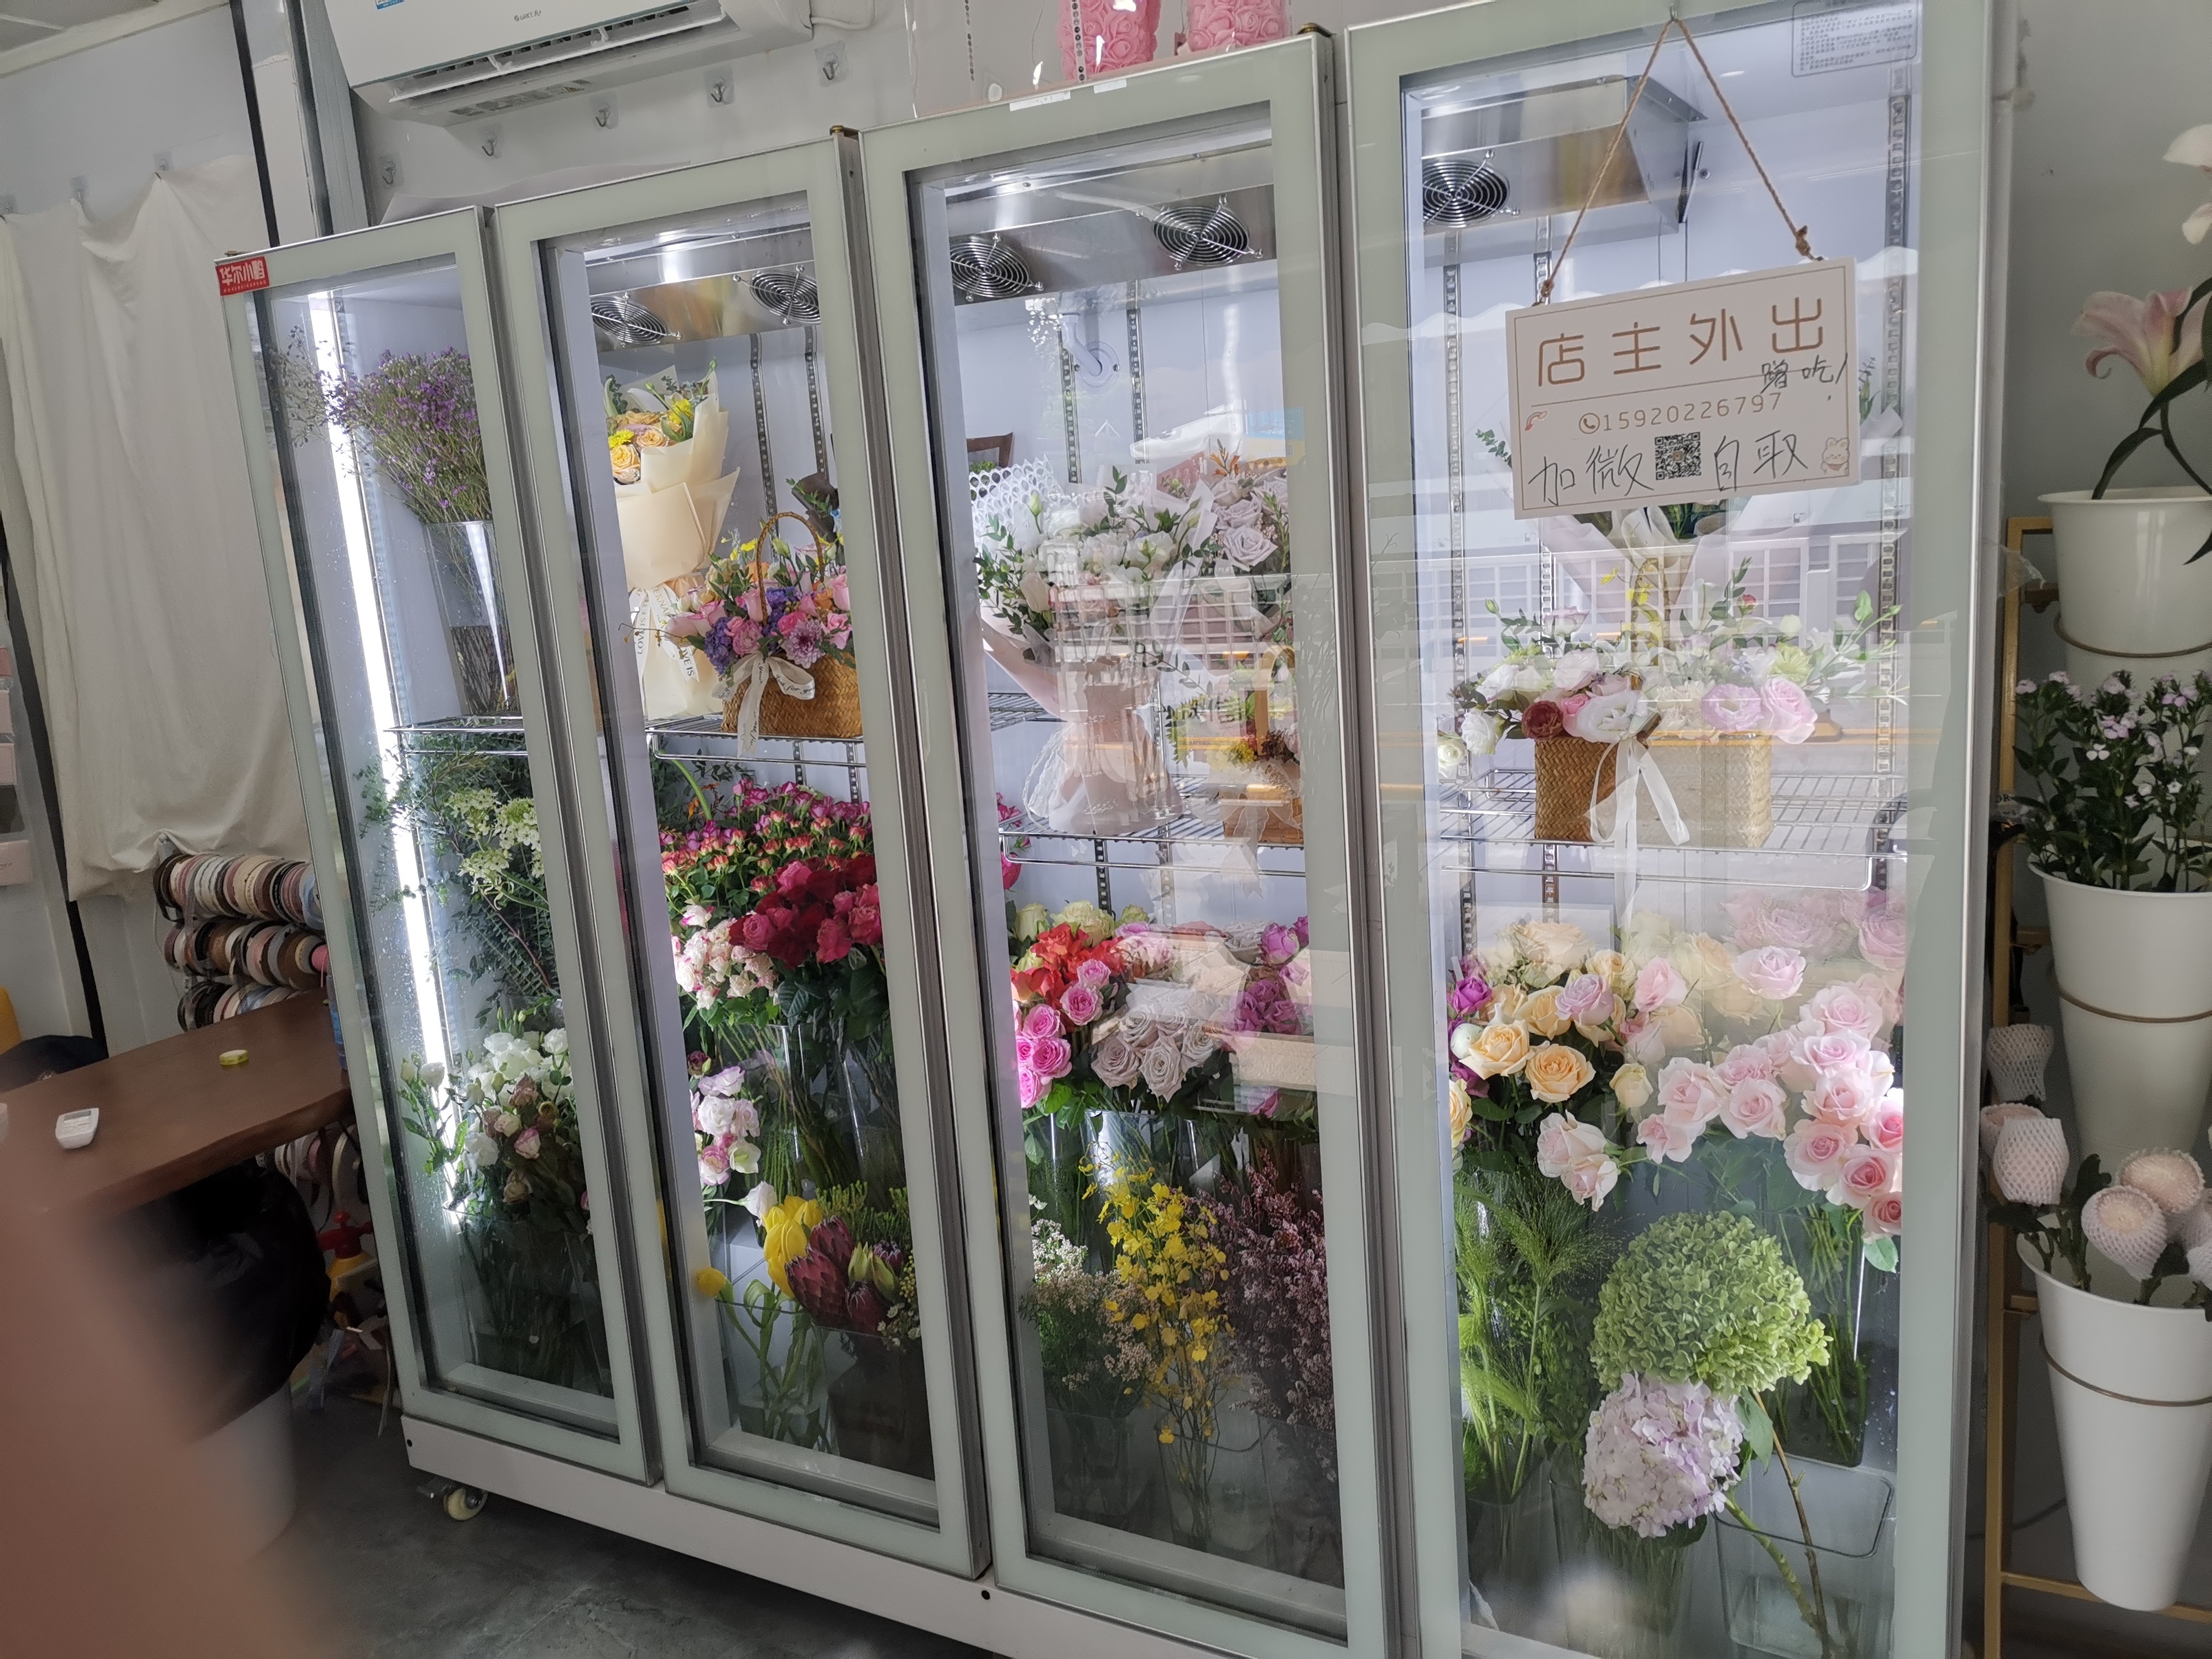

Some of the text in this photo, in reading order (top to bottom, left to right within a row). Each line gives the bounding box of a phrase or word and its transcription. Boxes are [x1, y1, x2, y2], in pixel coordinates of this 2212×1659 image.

[1538, 296, 1824, 387] 店主外出
[1603, 392, 1782, 432] 15920226797
[1528, 430, 1808, 506] 加微 自取
